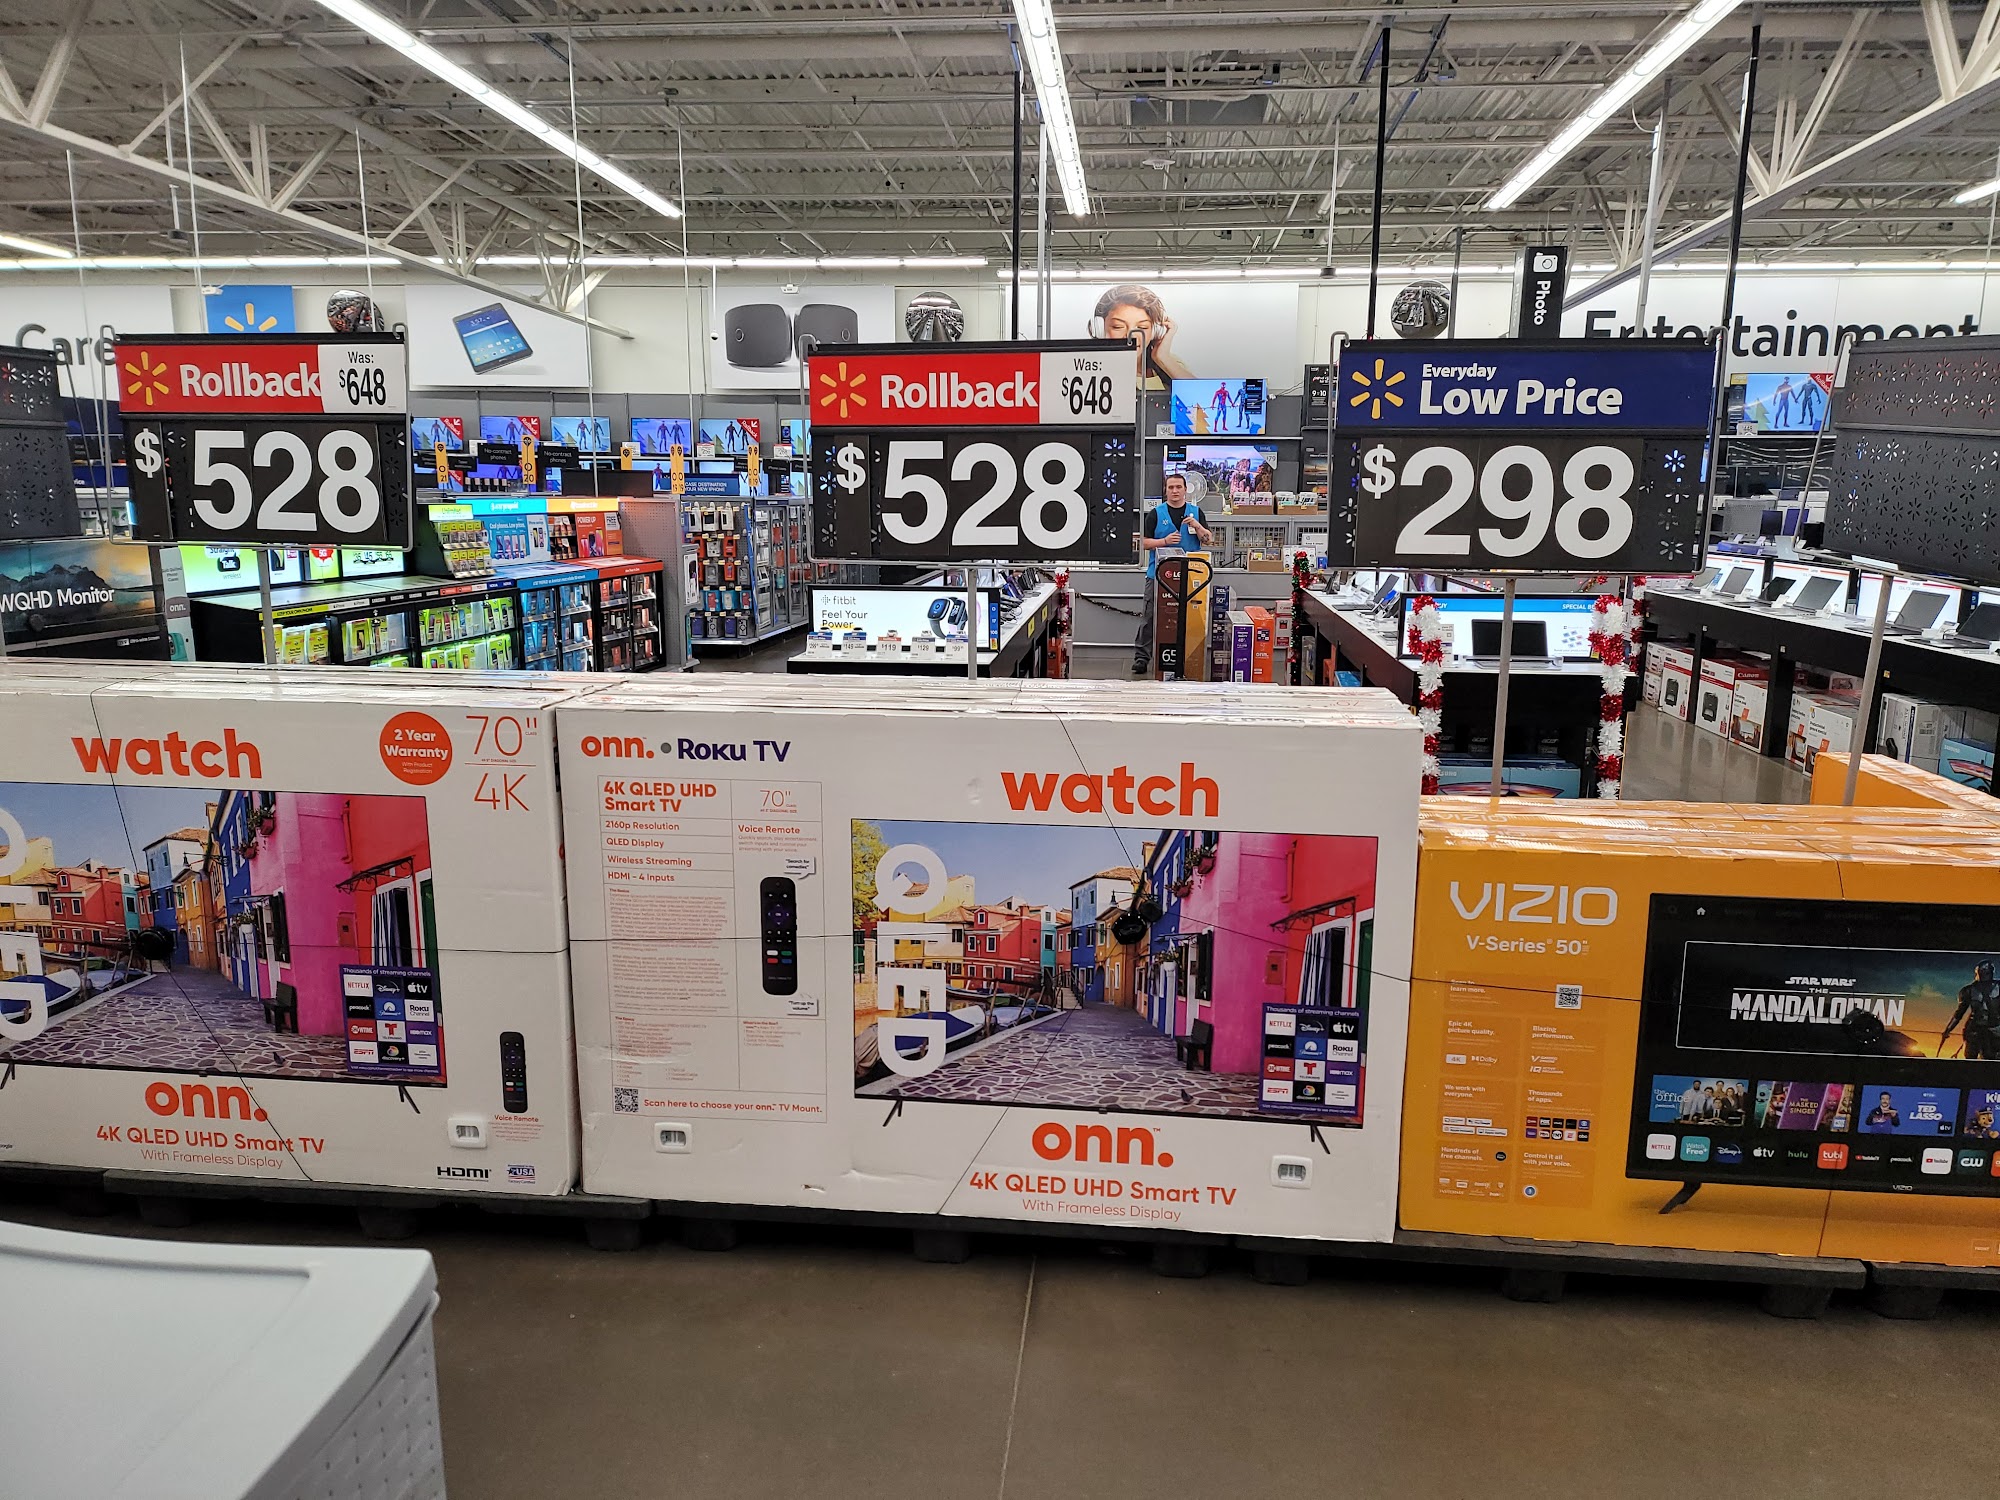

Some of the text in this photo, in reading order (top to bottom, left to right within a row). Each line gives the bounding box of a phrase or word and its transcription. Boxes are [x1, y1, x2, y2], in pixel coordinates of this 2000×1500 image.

[1534, 280, 1551, 326] Photo
[347, 351, 375, 364] Was:
[1073, 358, 1103, 372] Was:
[1422, 363, 1498, 381] Everyday
[179, 362, 322, 397] Rollback
[339, 367, 387, 406] $648
[880, 371, 1039, 409] Rollback
[1061, 375, 1113, 415] $648
[1419, 377, 1623, 415] Low Price
[440, 474, 447, 482] 21
[523, 474, 535, 483] 20
[1361, 444, 1635, 559] $298
[0, 586, 115, 613] WQHD Monitor
[833, 595, 857, 606] fitbit
[169, 604, 187, 612] onn.
[821, 609, 868, 619] Feel Your
[821, 619, 854, 629] Power
[394, 729, 437, 742] 2 Year
[466, 716, 538, 757] 70"
[70, 728, 263, 779] watch
[384, 744, 449, 761] Warranty
[580, 735, 792, 763] onn. Roku TV
[473, 773, 530, 812] 4K
[603, 781, 717, 798] 4K QLED UHD
[1000, 762, 1220, 818] watch
[604, 796, 682, 813] Smart TV
[760, 789, 791, 808] 70"
[605, 820, 680, 831] 2160p Resolution
[738, 824, 801, 834] Voice Remote
[606, 837, 665, 849] QLED Display
[607, 855, 692, 868] Wireless Streaming
[607, 871, 630, 881] HDMI
[638, 873, 645, 881] 4
[647, 873, 675, 883] Inputs
[1449, 880, 1619, 927] VIZIO
[872, 843, 949, 1078] QLED
[343, 967, 372, 975] Thousands
[379, 969, 407, 977] streaming
[1785, 976, 1857, 987] STAR WARS
[409, 1004, 430, 1012] Roku
[1266, 1006, 1360, 1018] Thousands of streaming channels
[1268, 1020, 1292, 1028] NETFLIX
[1448, 1020, 1462, 1028] Epic
[1532, 1025, 1557, 1034] Blazing
[1447, 1027, 1495, 1036] picture quality.
[1532, 1031, 1575, 1041] performance.
[1332, 1044, 1354, 1052] Roku
[1443, 1091, 1474, 1099] everyone.
[1528, 1089, 1563, 1097] Thousands
[144, 1080, 269, 1122] onn.
[643, 1098, 666, 1108] Scan
[667, 1099, 688, 1108] here
[689, 1101, 699, 1109] to
[700, 1100, 733, 1110] choose
[734, 1103, 754, 1112] your
[779, 1103, 791, 1112] TV
[792, 1105, 823, 1114] Mount.
[1788, 1101, 1819, 1109] MASKED
[1789, 1107, 1816, 1115] SINGER
[1917, 1104, 1938, 1113] TED
[1909, 1111, 1943, 1121] LASSO
[96, 1126, 325, 1154] 4K QLED UHD Smart TV
[1031, 1122, 1175, 1168] onn.
[1441, 1146, 1472, 1154] Hundreds
[1651, 1143, 1672, 1151] NETFLIX
[140, 1149, 284, 1170] With Frameless Display
[1787, 1150, 1809, 1159] hulu
[1822, 1150, 1843, 1160] tubi
[1960, 1157, 1984, 1168] CW
[436, 1166, 489, 1179] HDMI
[516, 1168, 535, 1176] USA
[969, 1172, 1238, 1206] 4K QLED UHD Smart TV
[1022, 1198, 1182, 1223] With Frameless Display
